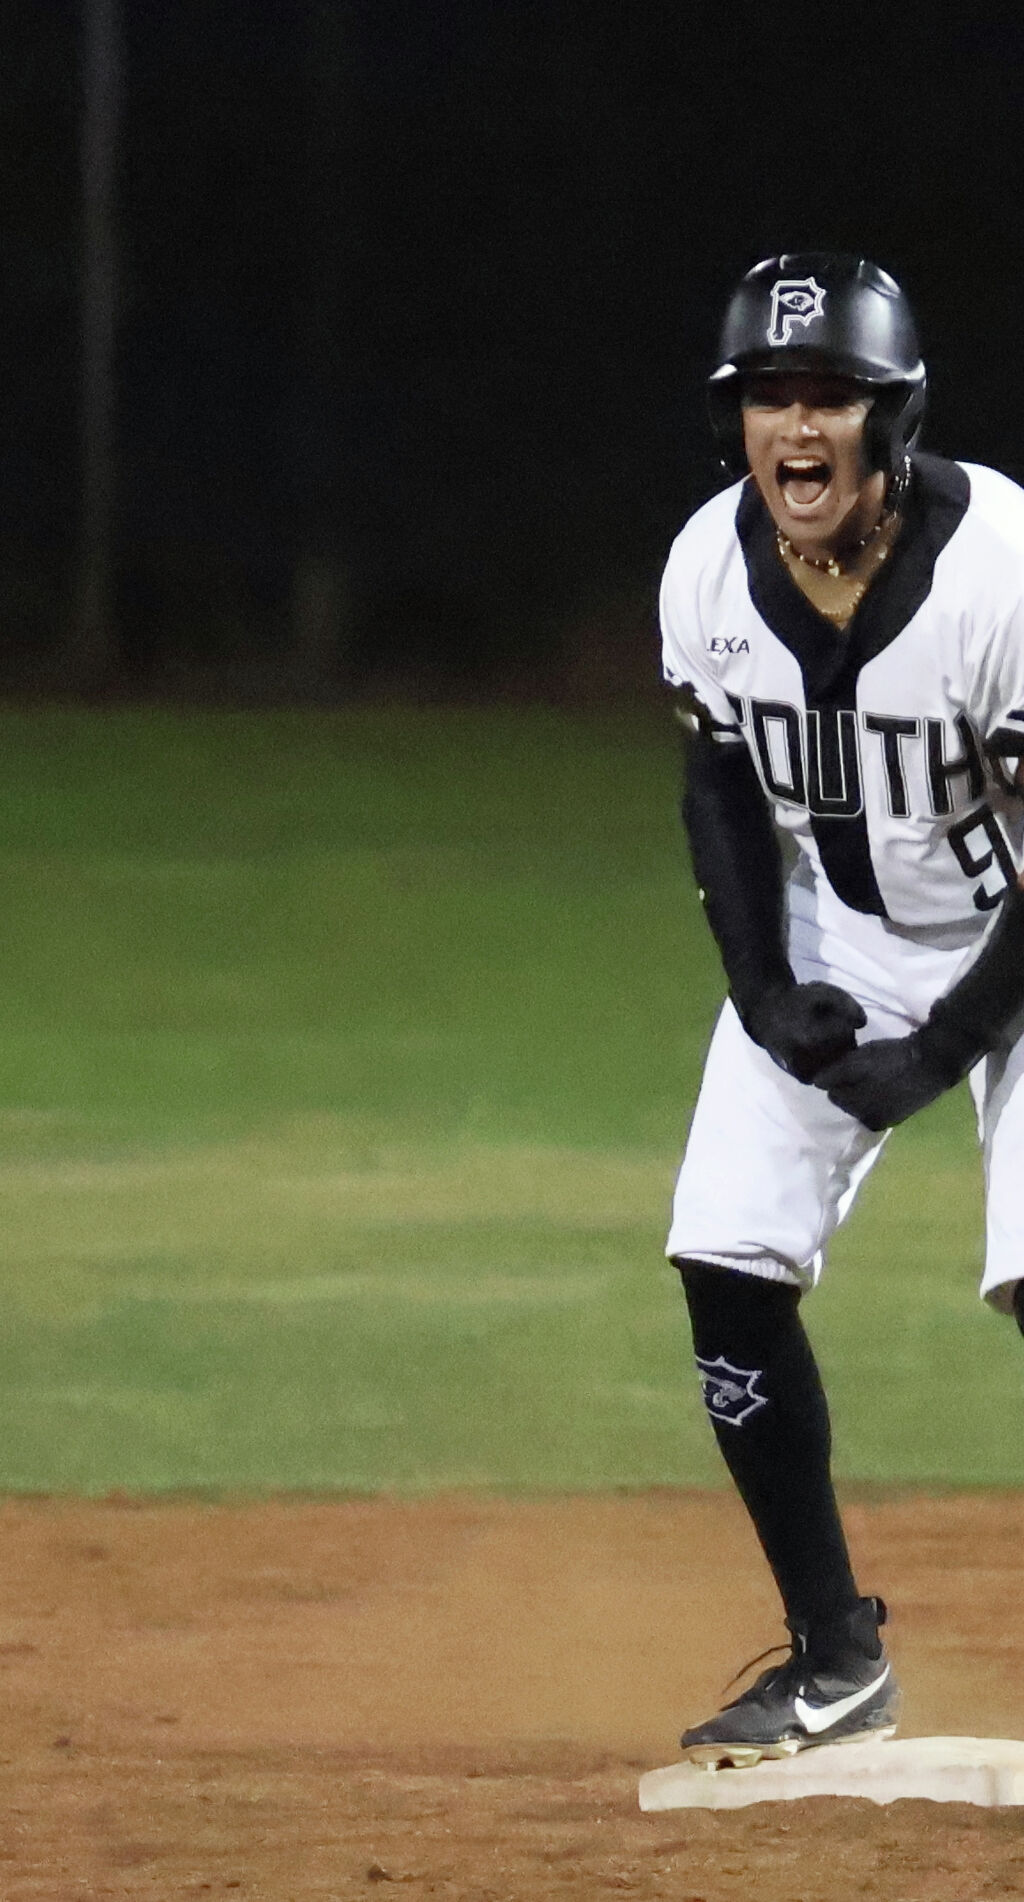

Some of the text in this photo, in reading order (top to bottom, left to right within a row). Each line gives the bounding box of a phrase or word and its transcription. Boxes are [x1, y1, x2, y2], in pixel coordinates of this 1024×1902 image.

[706, 636, 750, 655] EXA
[724, 690, 994, 818] OUTH
[947, 803, 1019, 912] 9
